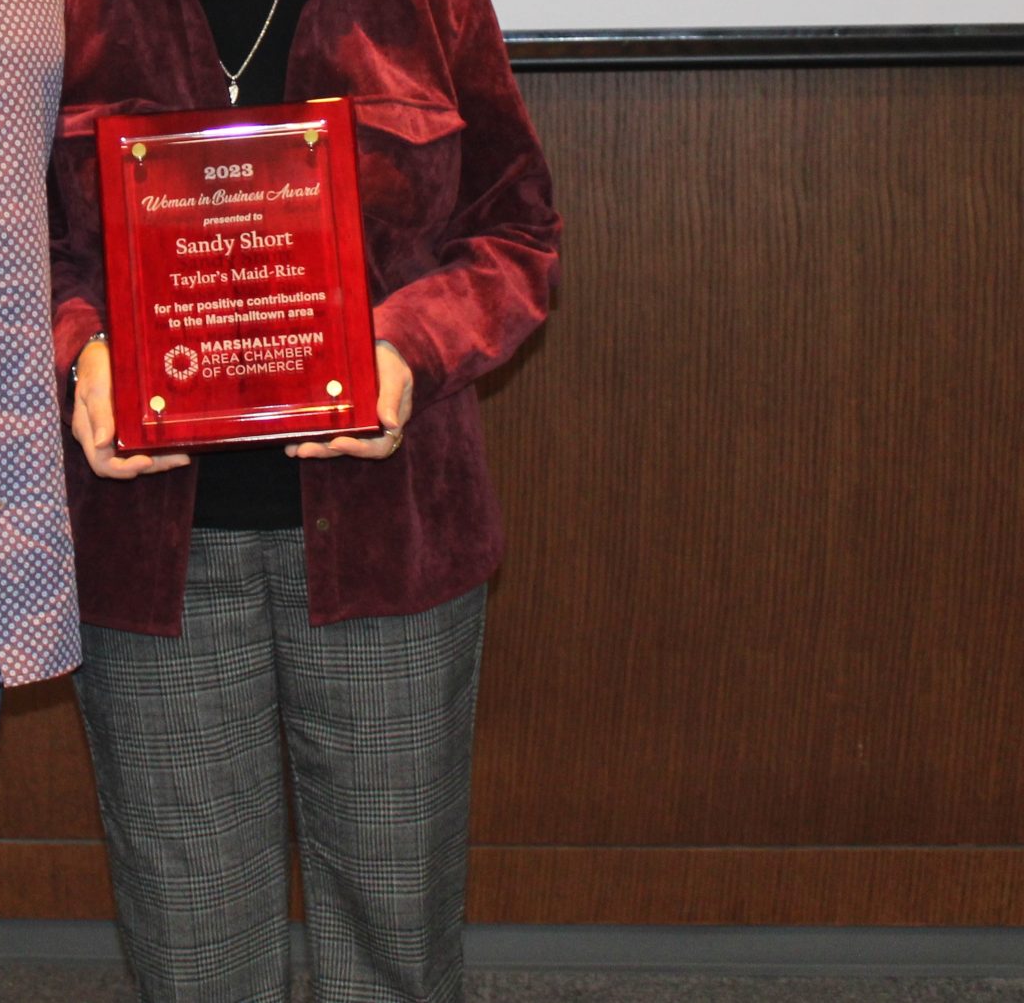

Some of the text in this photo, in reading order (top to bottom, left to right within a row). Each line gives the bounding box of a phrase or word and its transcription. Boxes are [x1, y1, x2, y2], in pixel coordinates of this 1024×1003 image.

[204, 163, 254, 180] 2023
[141, 182, 320, 212] Woman in Business Award
[203, 213, 263, 227] presented to
[176, 231, 294, 256] Sandy Short
[231, 264, 305, 282] Maid-Rite
[154, 291, 326, 315] for her positive contributions
[168, 307, 315, 329] to the Marshalltown area
[201, 332, 324, 352] MARSHALLTOWN
[202, 346, 313, 365] AREA CHAMBER
[202, 359, 304, 379] OF COMMERCE
